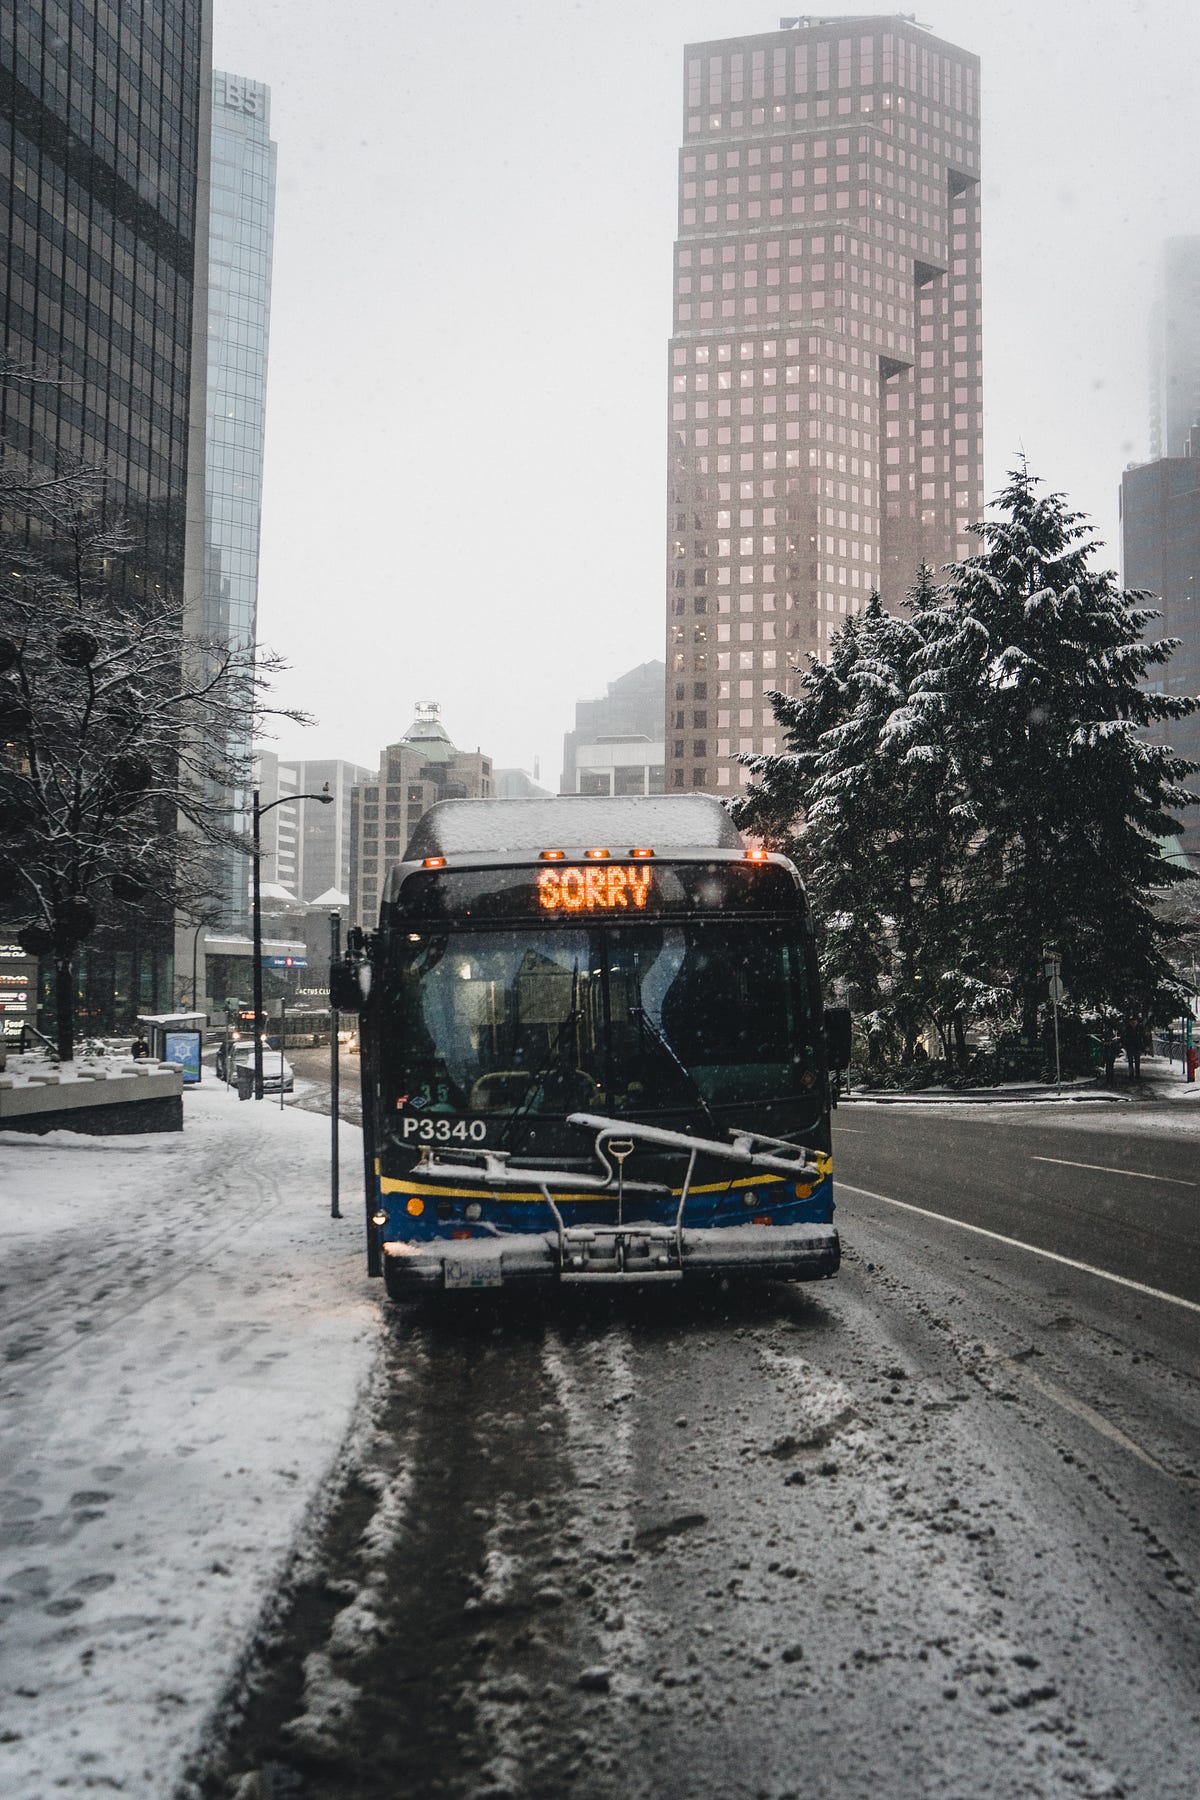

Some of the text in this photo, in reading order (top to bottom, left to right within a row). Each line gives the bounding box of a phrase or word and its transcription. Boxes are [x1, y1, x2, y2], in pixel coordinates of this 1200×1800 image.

[539, 865, 650, 909] SORRY
[295, 988, 331, 996] CACTUS CLU
[5, 1020, 24, 1028] Food
[4, 1028, 22, 1036] Cour
[403, 1117, 487, 1141] P3340
